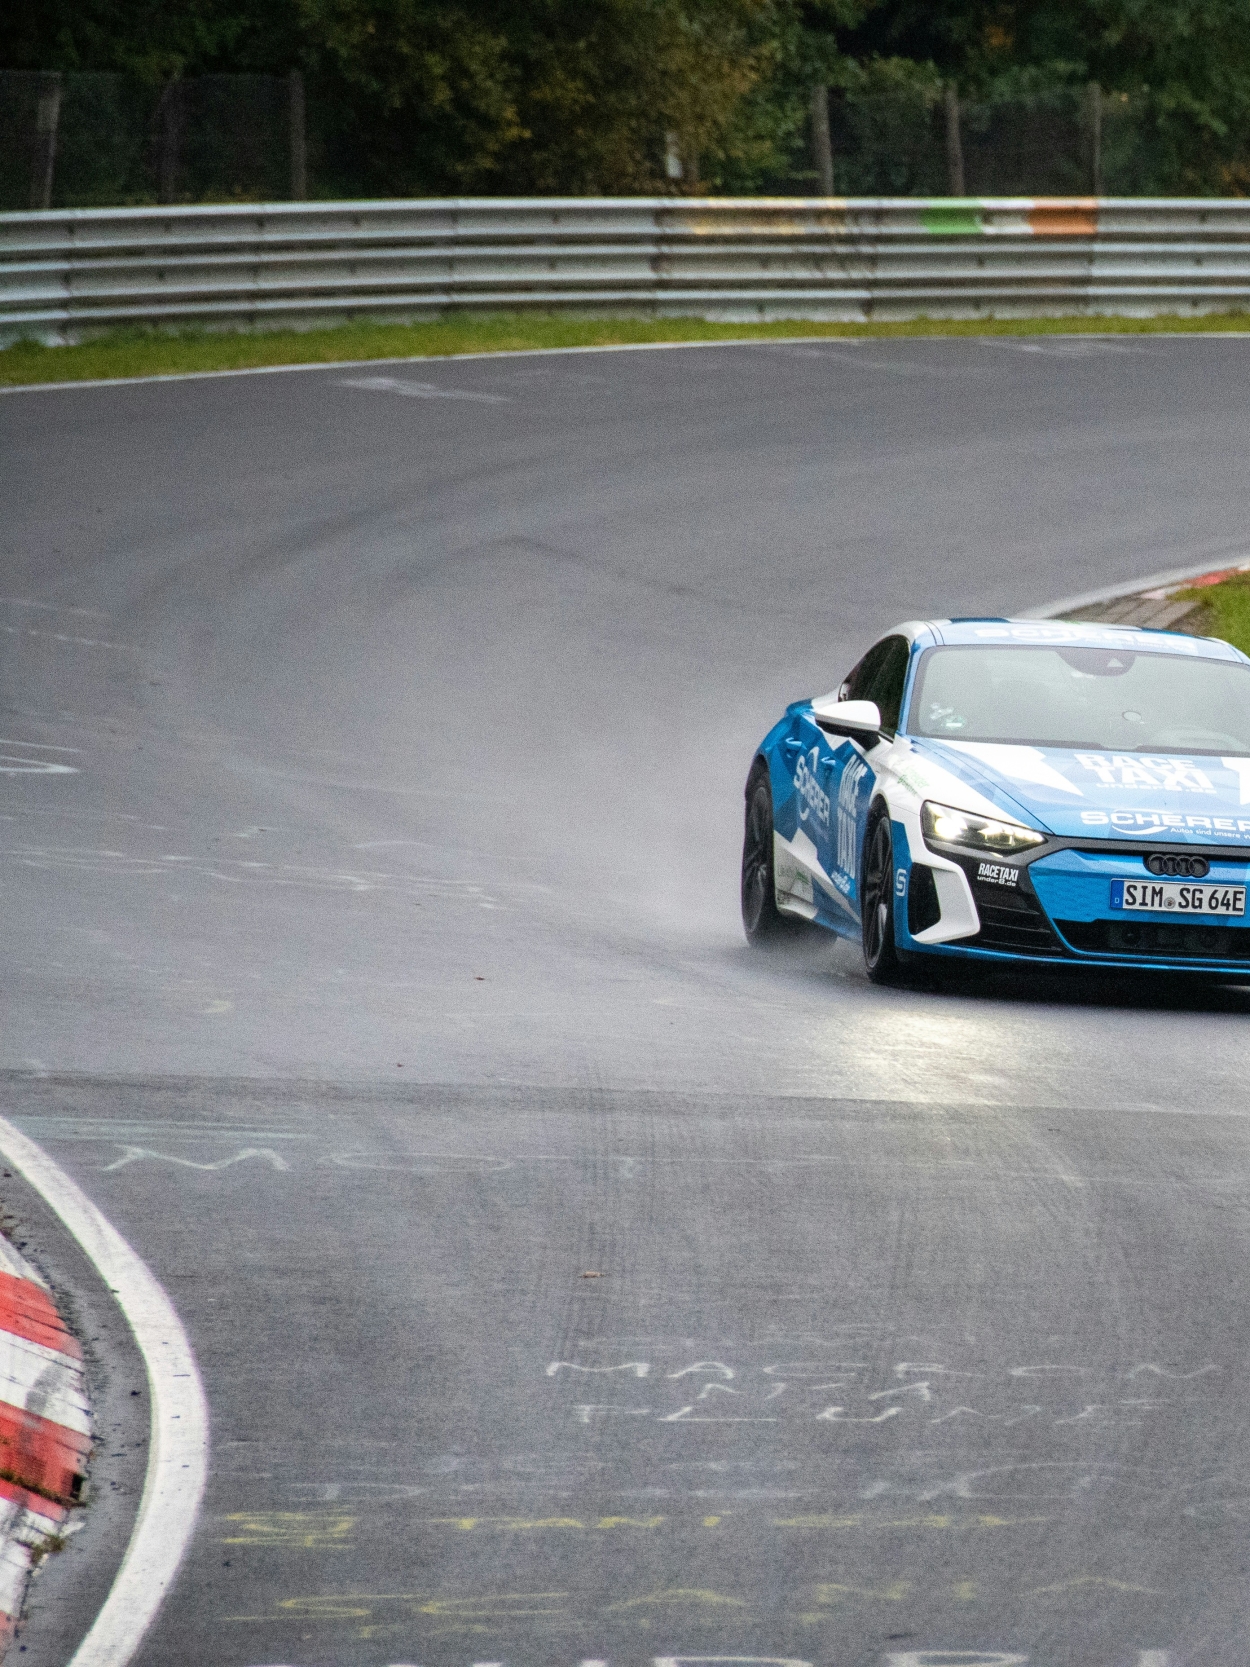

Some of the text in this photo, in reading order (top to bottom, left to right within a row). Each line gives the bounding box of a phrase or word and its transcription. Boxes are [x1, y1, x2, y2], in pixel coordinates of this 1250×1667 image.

[1074, 753, 1196, 771] RACE
[1097, 766, 1215, 789] TAXI
[1196, 828, 1212, 836] sind
[1213, 830, 1241, 839] unsere
[1124, 884, 1245, 912] SIM SG 64E
